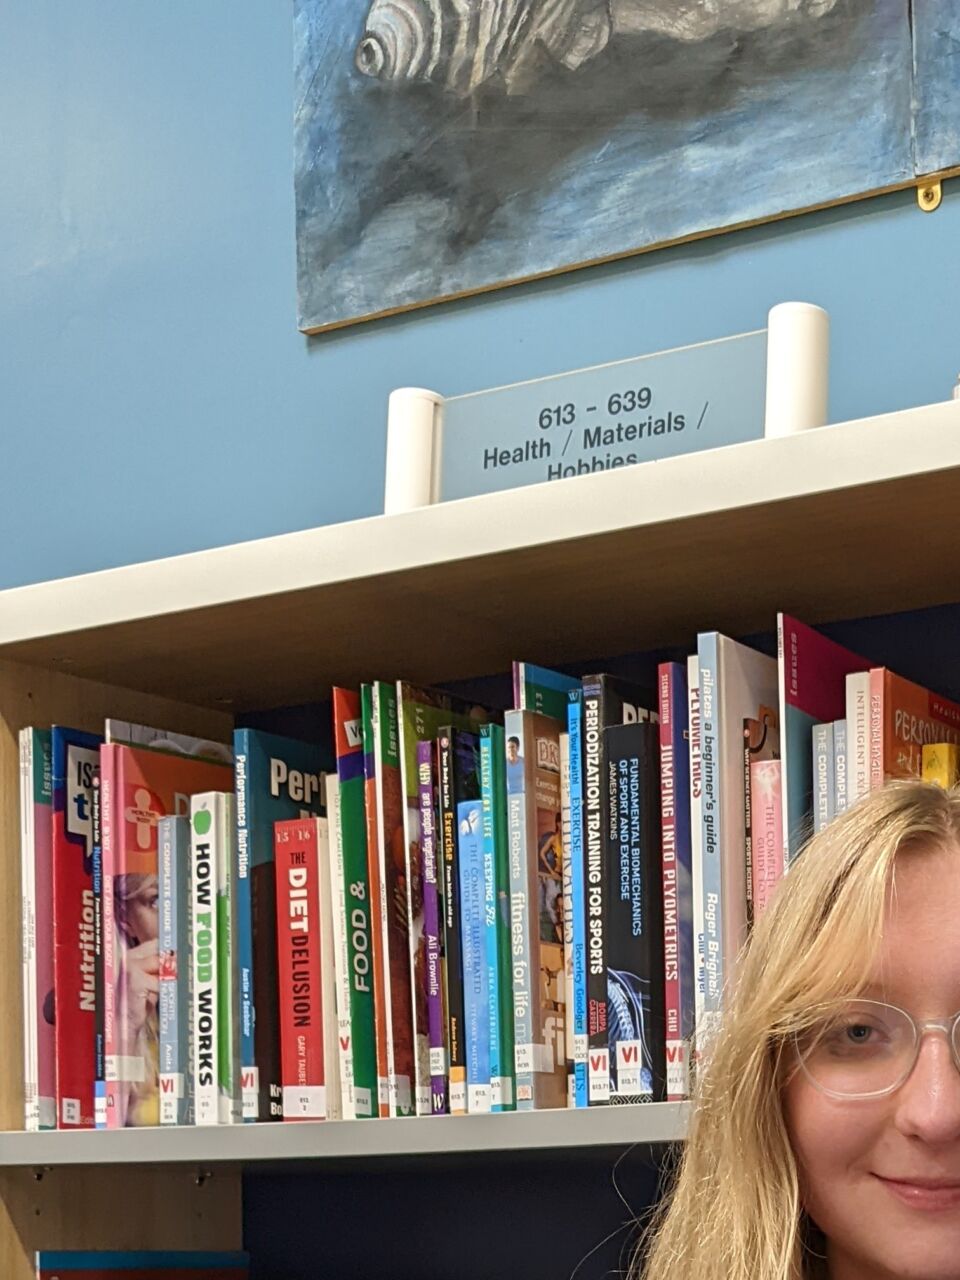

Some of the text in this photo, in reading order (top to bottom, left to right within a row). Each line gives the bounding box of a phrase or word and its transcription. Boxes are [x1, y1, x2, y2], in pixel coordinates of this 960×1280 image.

[483, 402, 708, 469] Health / Materials /
[539, 402, 576, 430] 613
[607, 386, 652, 415] 639
[237, 755, 249, 878] Performance Nutrition
[701, 669, 717, 854] pilates a beginner's guide
[290, 853, 306, 866] THE
[419, 763, 439, 995] WHY are people vegetarian? Ali Brownlie
[585, 700, 602, 974] PERIODIZATION TRAINING FOR SPORTS
[660, 744, 677, 1032] JUMPING INTO PLYOMETRICS CHU
[80, 890, 96, 1011] Nutrition
[196, 843, 213, 1086] HOW FOOD WORKS
[289, 868, 310, 1027] DIET DELUSION
[512, 892, 528, 1017] fitness for life
